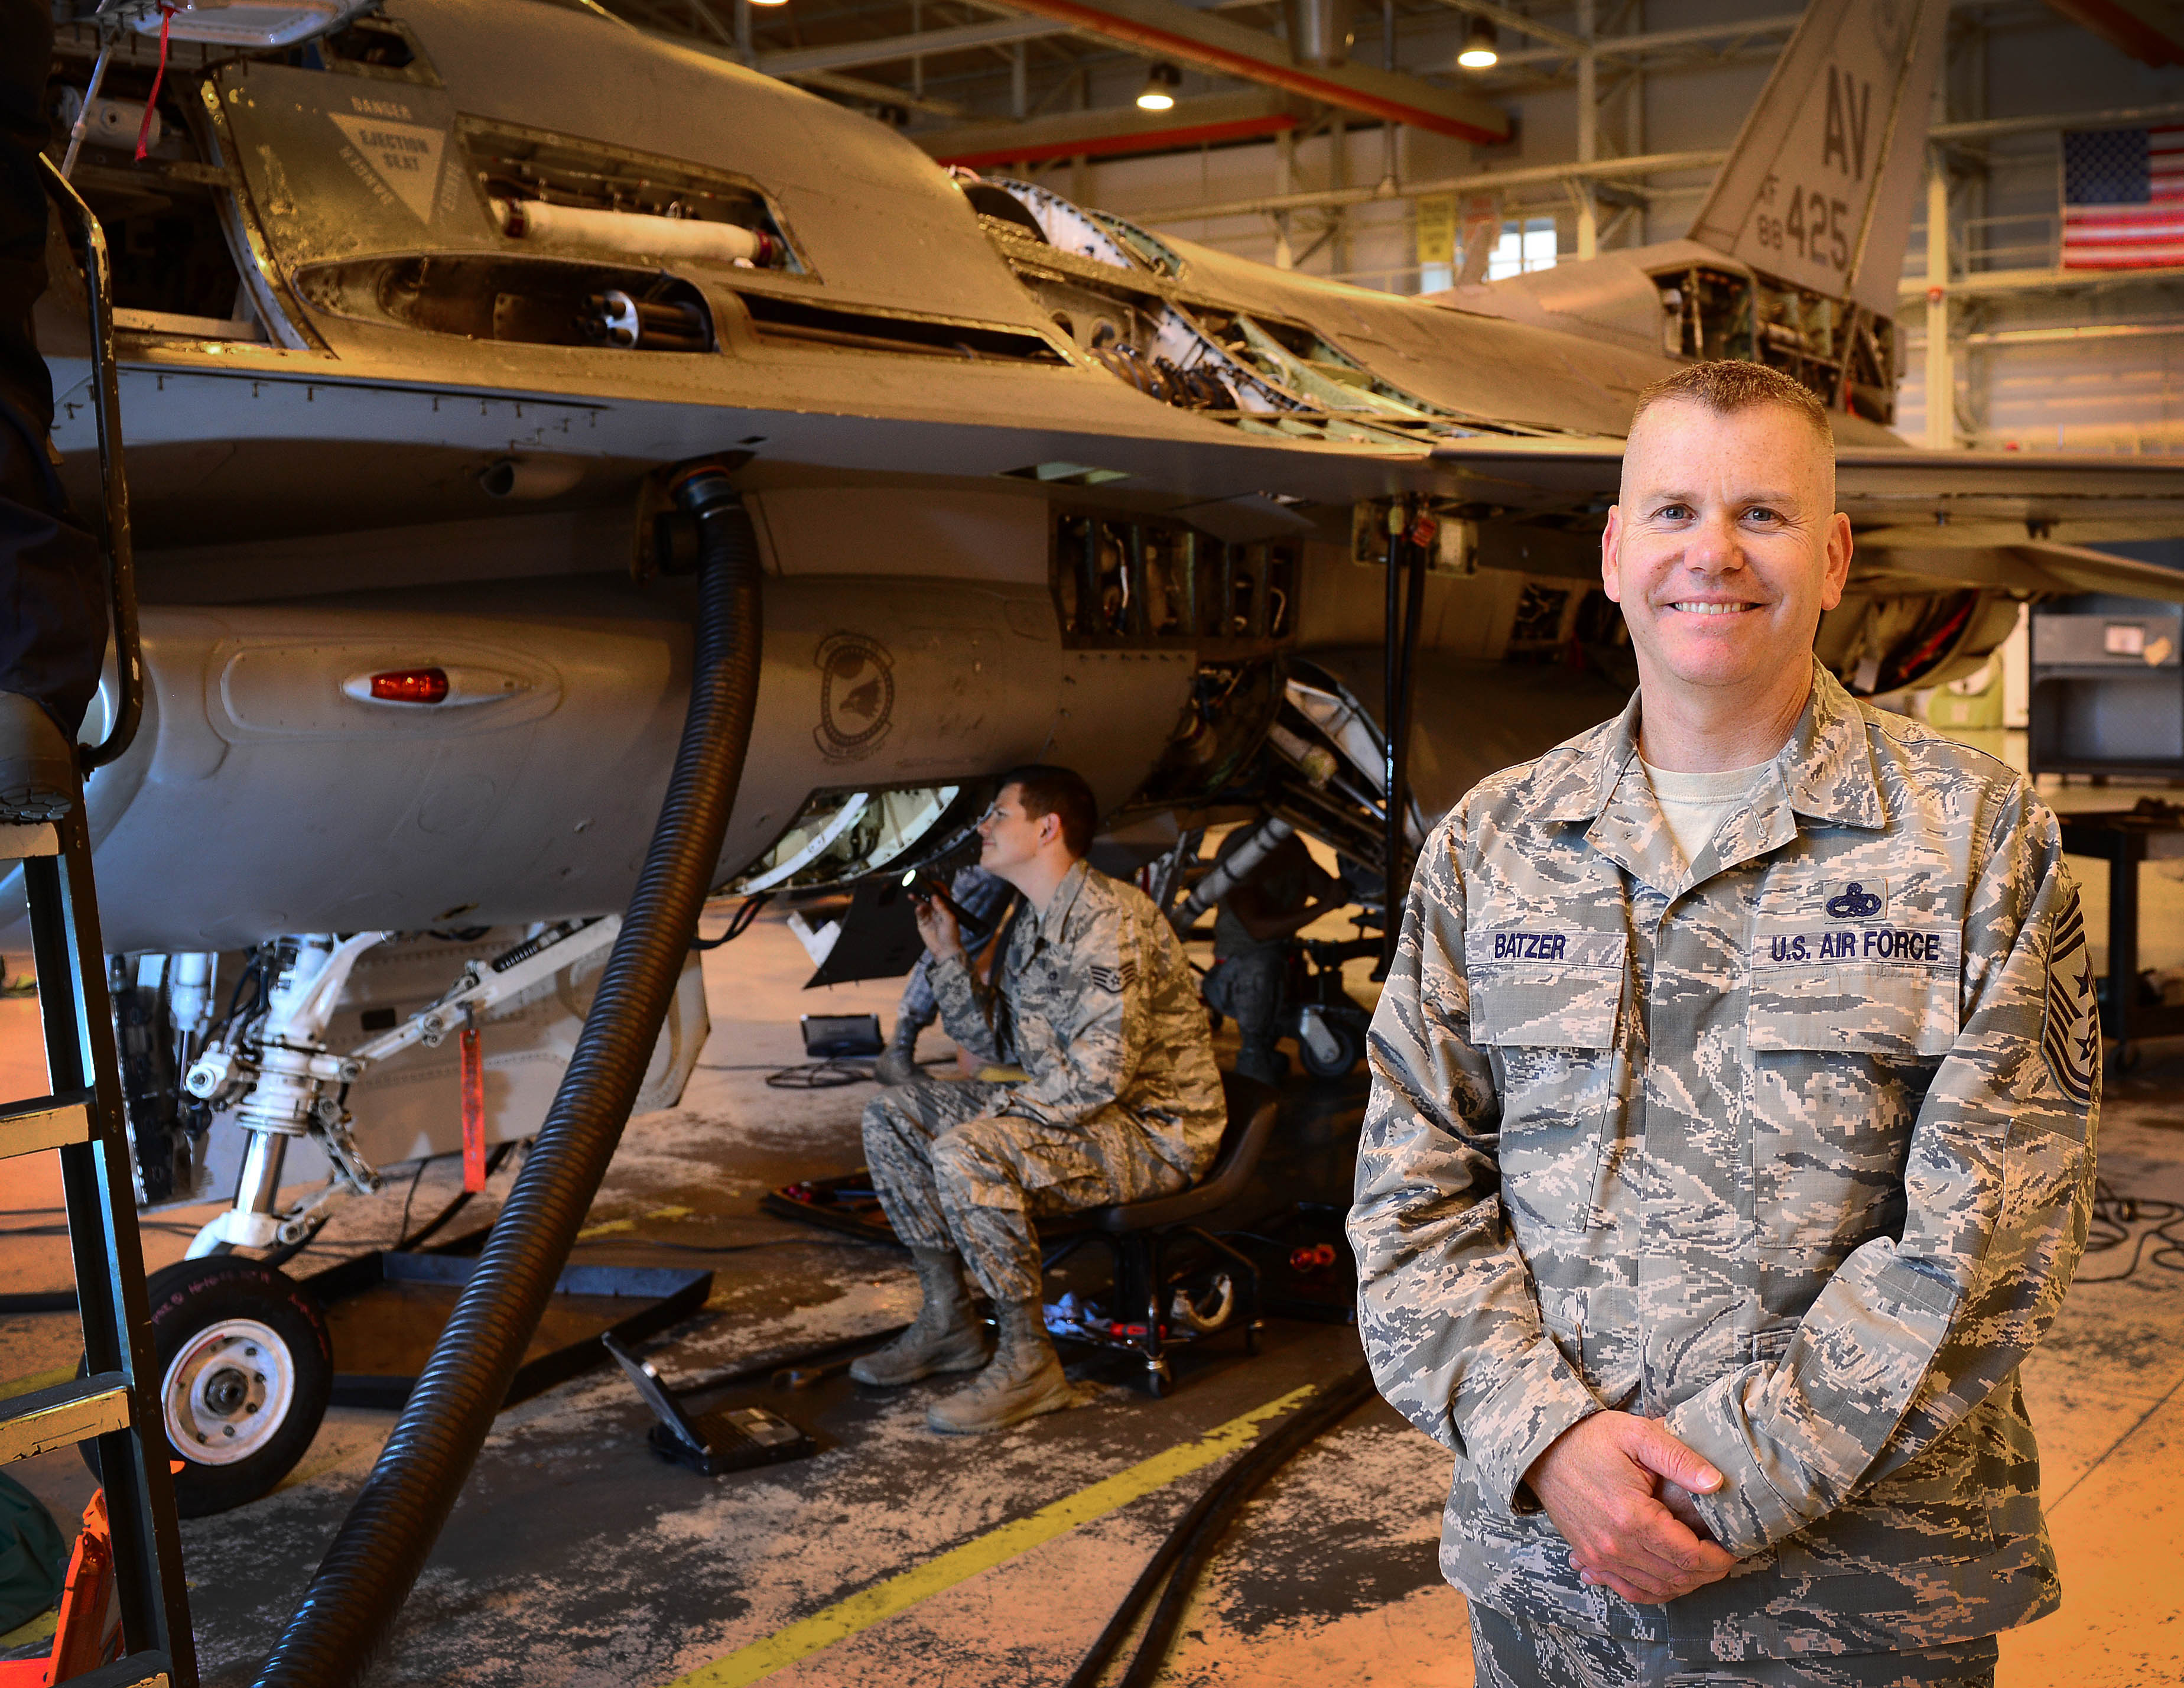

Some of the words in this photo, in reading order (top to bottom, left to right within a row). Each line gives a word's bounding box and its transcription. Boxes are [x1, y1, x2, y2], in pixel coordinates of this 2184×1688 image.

[1822, 63, 1870, 180] AV
[359, 129, 430, 155] EJECTION
[384, 152, 420, 172] SEAT
[1786, 184, 1848, 272] 425
[1494, 933, 1566, 960] BATZER
[1772, 935, 1811, 962] U.S.
[1819, 932, 1856, 959] AIR
[1863, 929, 1940, 962] FORCE
